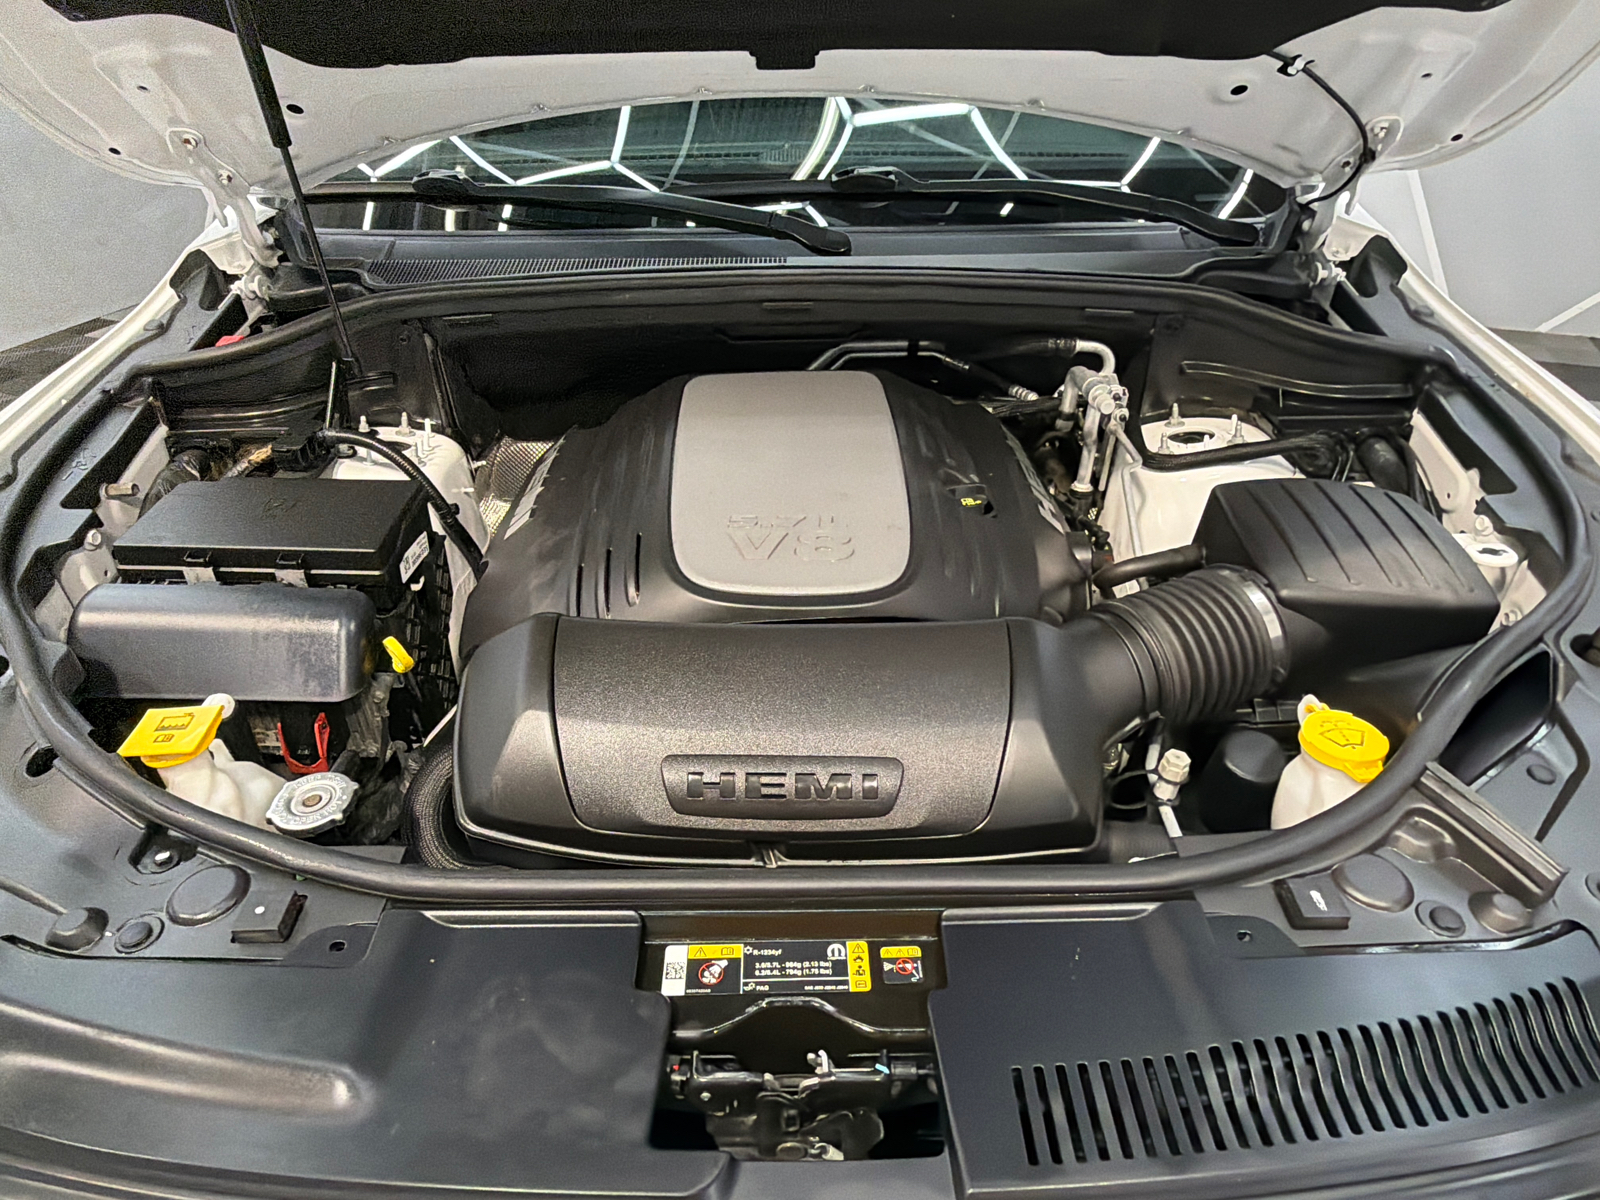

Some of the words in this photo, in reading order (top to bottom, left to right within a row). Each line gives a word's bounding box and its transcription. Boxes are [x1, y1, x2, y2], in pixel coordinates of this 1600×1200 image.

[726, 531, 855, 562] V8
[686, 771, 879, 800] HEMI
[752, 948, 782, 956] R-1234yf
